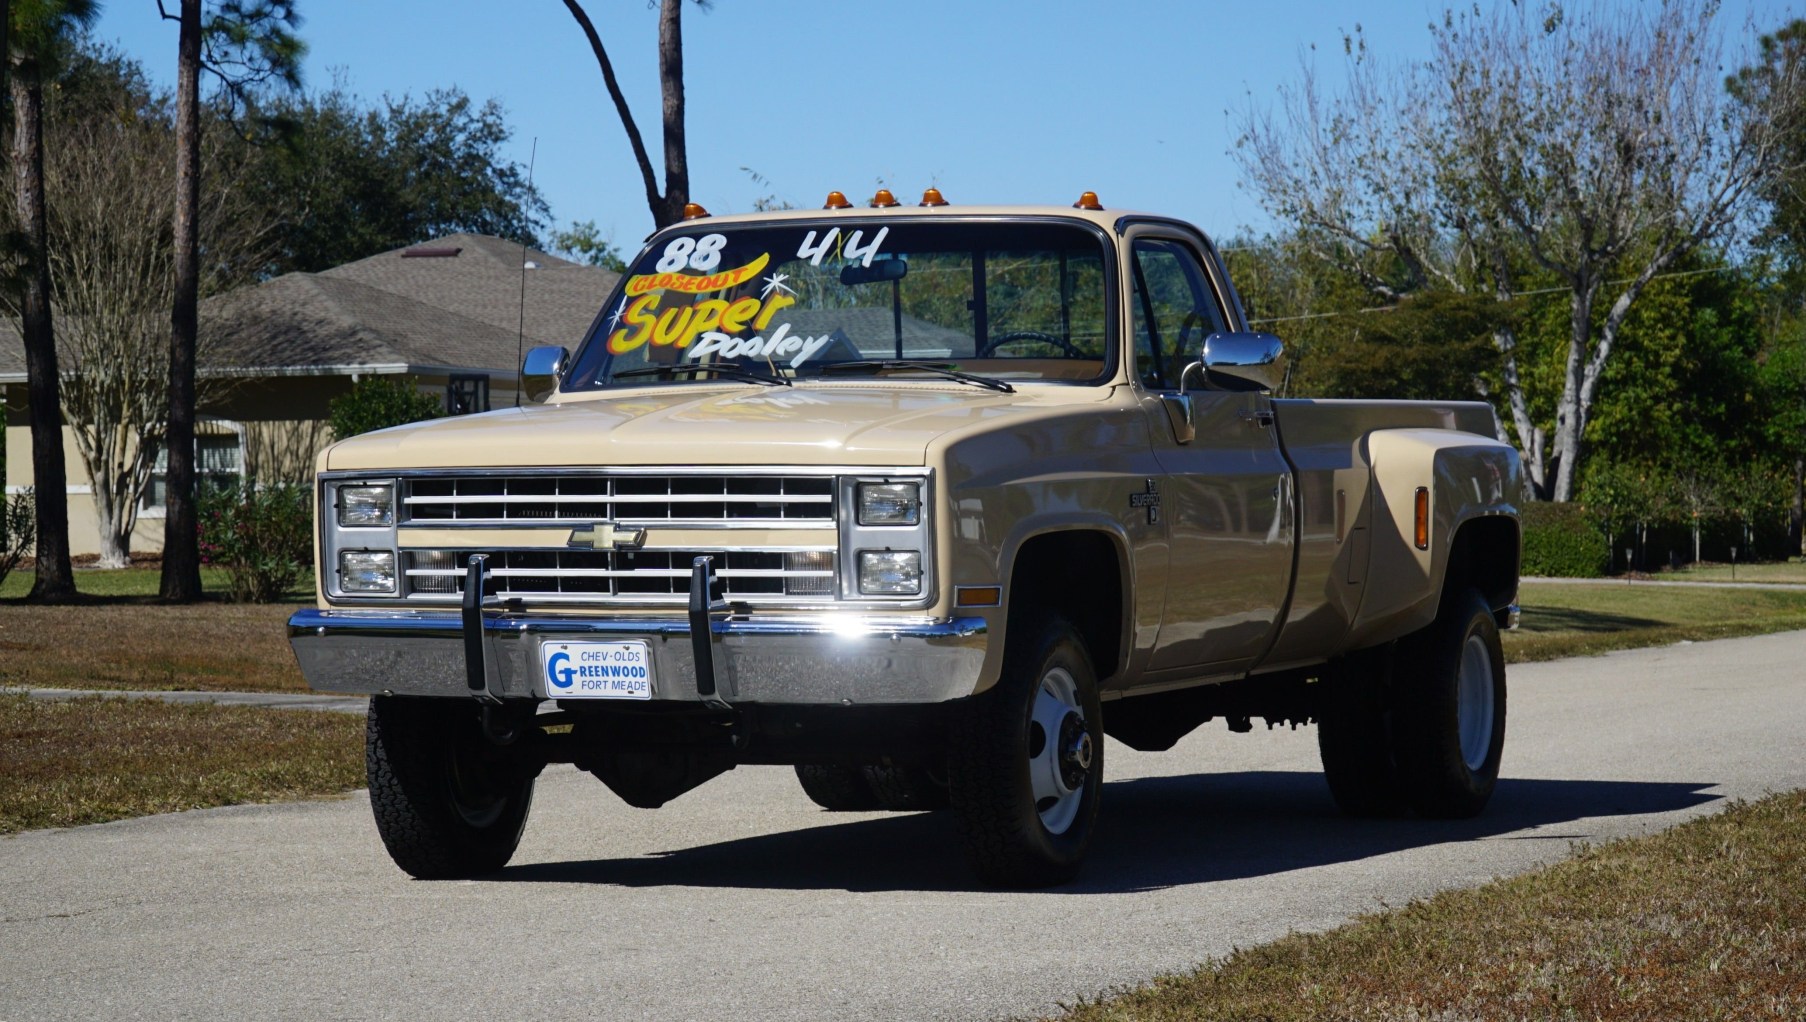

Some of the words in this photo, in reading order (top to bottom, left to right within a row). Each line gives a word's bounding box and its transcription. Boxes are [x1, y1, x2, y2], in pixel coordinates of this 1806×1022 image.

[656, 234, 727, 273] 88
[633, 267, 749, 291] CLOSEOUT
[688, 323, 829, 368] Dooley
[581, 680, 608, 690] FORT
[611, 681, 646, 691] MEADE
